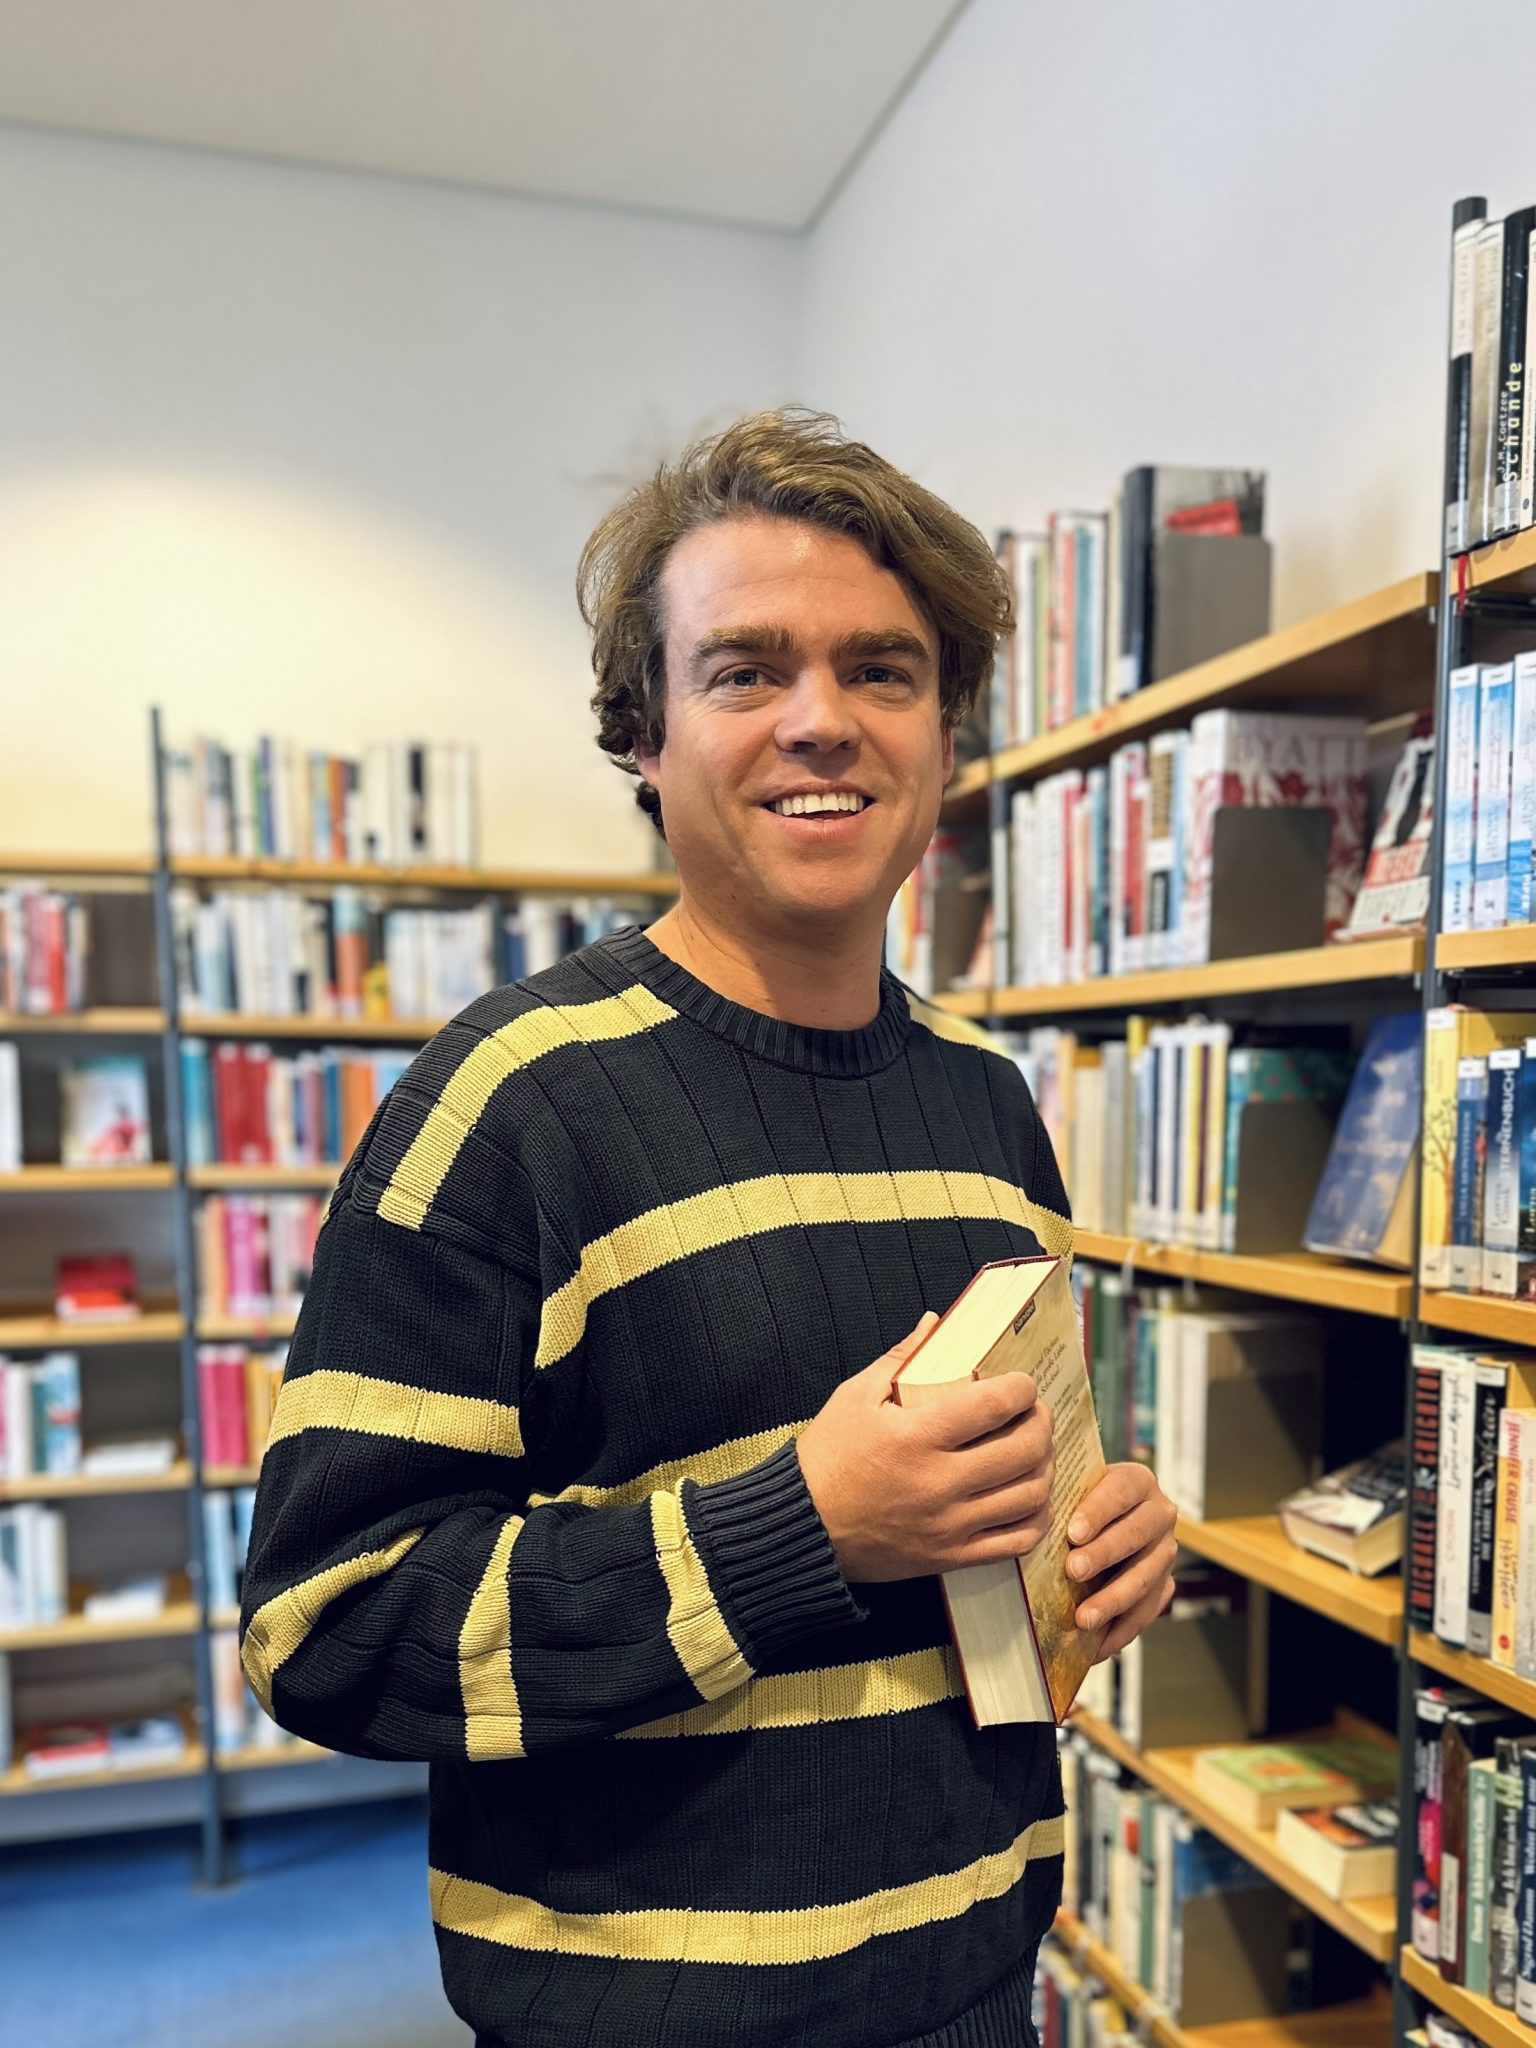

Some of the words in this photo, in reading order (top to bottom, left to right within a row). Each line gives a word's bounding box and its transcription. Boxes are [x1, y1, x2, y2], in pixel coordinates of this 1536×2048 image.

[1497, 390, 1509, 442] Coetzee
[1502, 362, 1522, 483] Schande
[1506, 1421, 1520, 1479] JENNIFER
[1504, 1482, 1517, 1523] CRUSIE
[1410, 1520, 1437, 1609] MICHAEL
[1523, 1888, 1535, 1936] Damm
[1520, 1936, 1535, 1980] Sigrid
